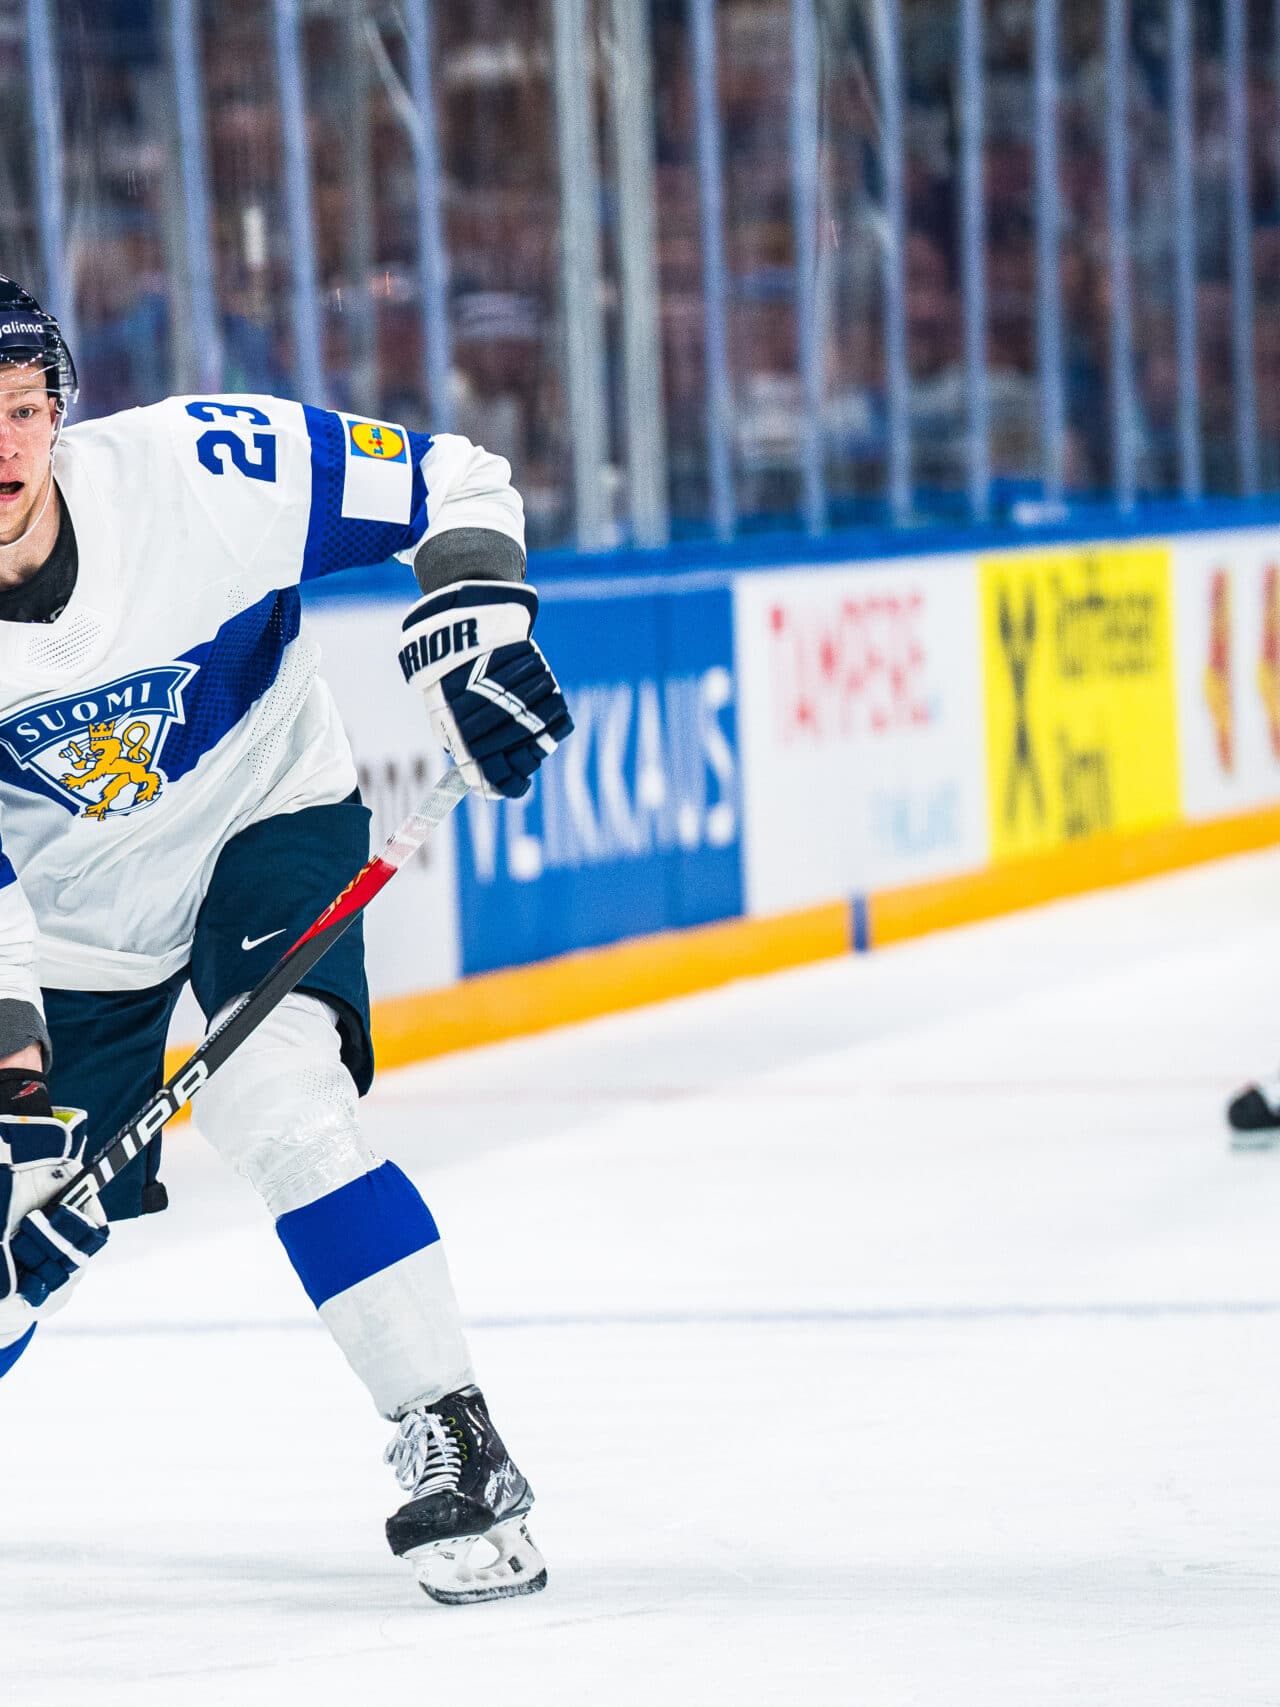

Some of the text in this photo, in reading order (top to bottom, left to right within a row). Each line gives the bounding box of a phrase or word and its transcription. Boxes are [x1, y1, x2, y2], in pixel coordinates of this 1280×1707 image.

[185, 402, 276, 483] 23
[16, 682, 151, 743] SUOMI
[62, 1060, 208, 1208] AUER
